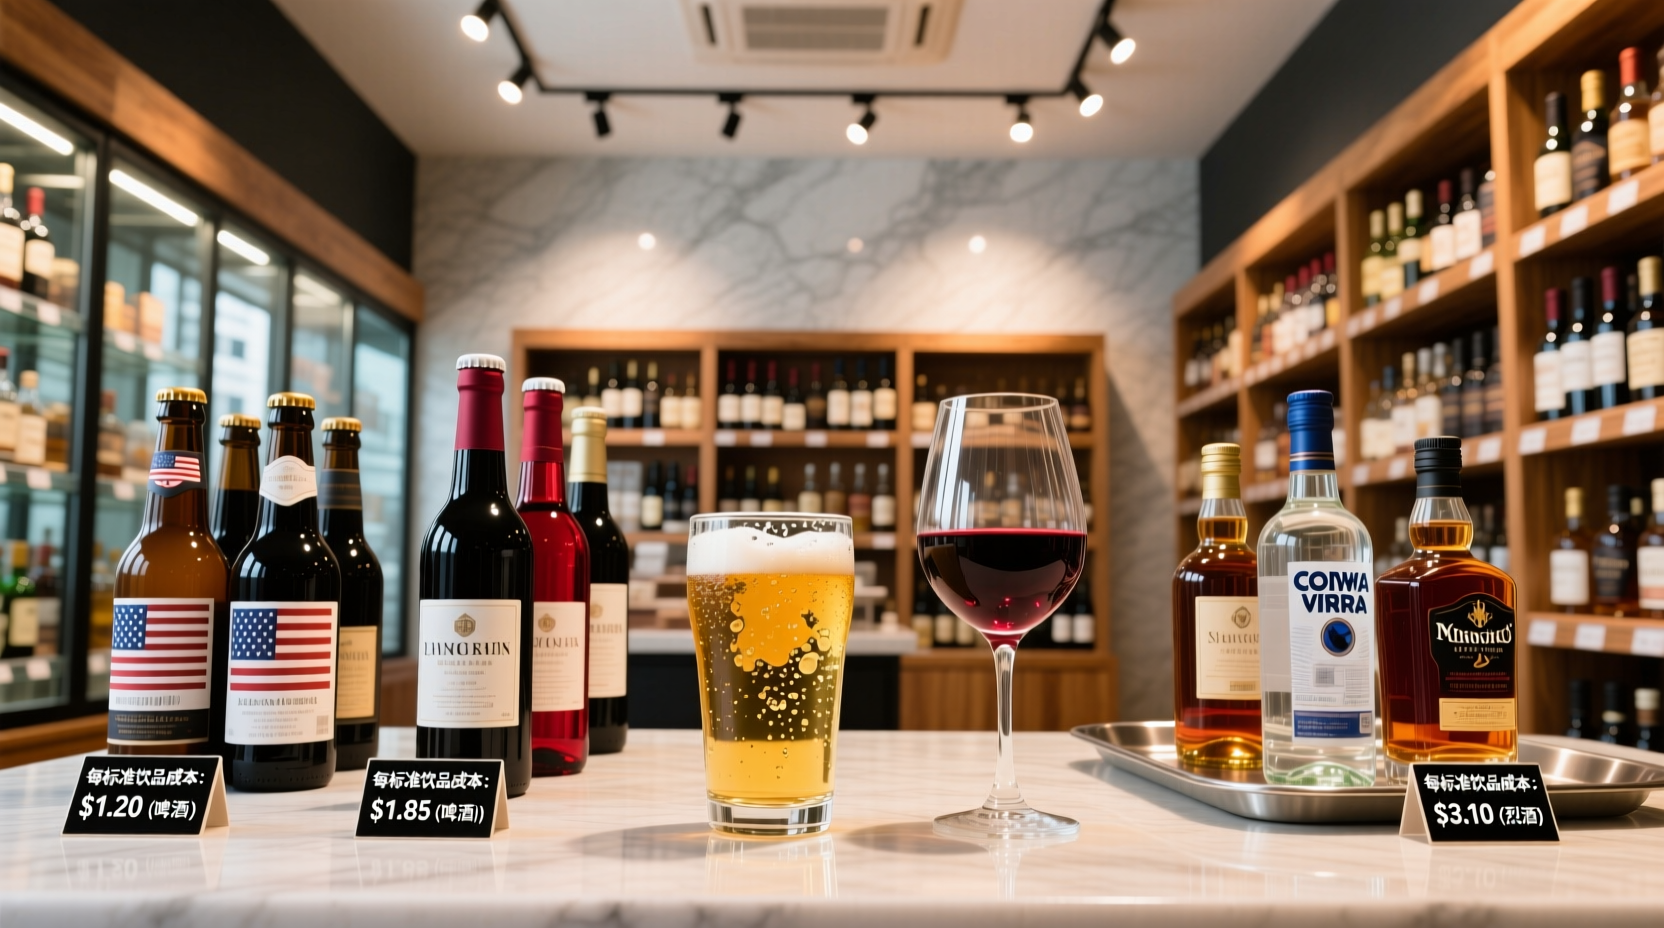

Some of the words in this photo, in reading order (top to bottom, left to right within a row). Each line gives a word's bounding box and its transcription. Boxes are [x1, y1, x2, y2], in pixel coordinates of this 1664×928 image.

[1301, 593, 1367, 615] VIRRA
[78, 792, 144, 821] $1.20
[148, 799, 197, 821] (啤酒)
[370, 796, 431, 824] $1.85
[1433, 800, 1494, 828] $3.10
[1499, 806, 1544, 827] (烈酒)
